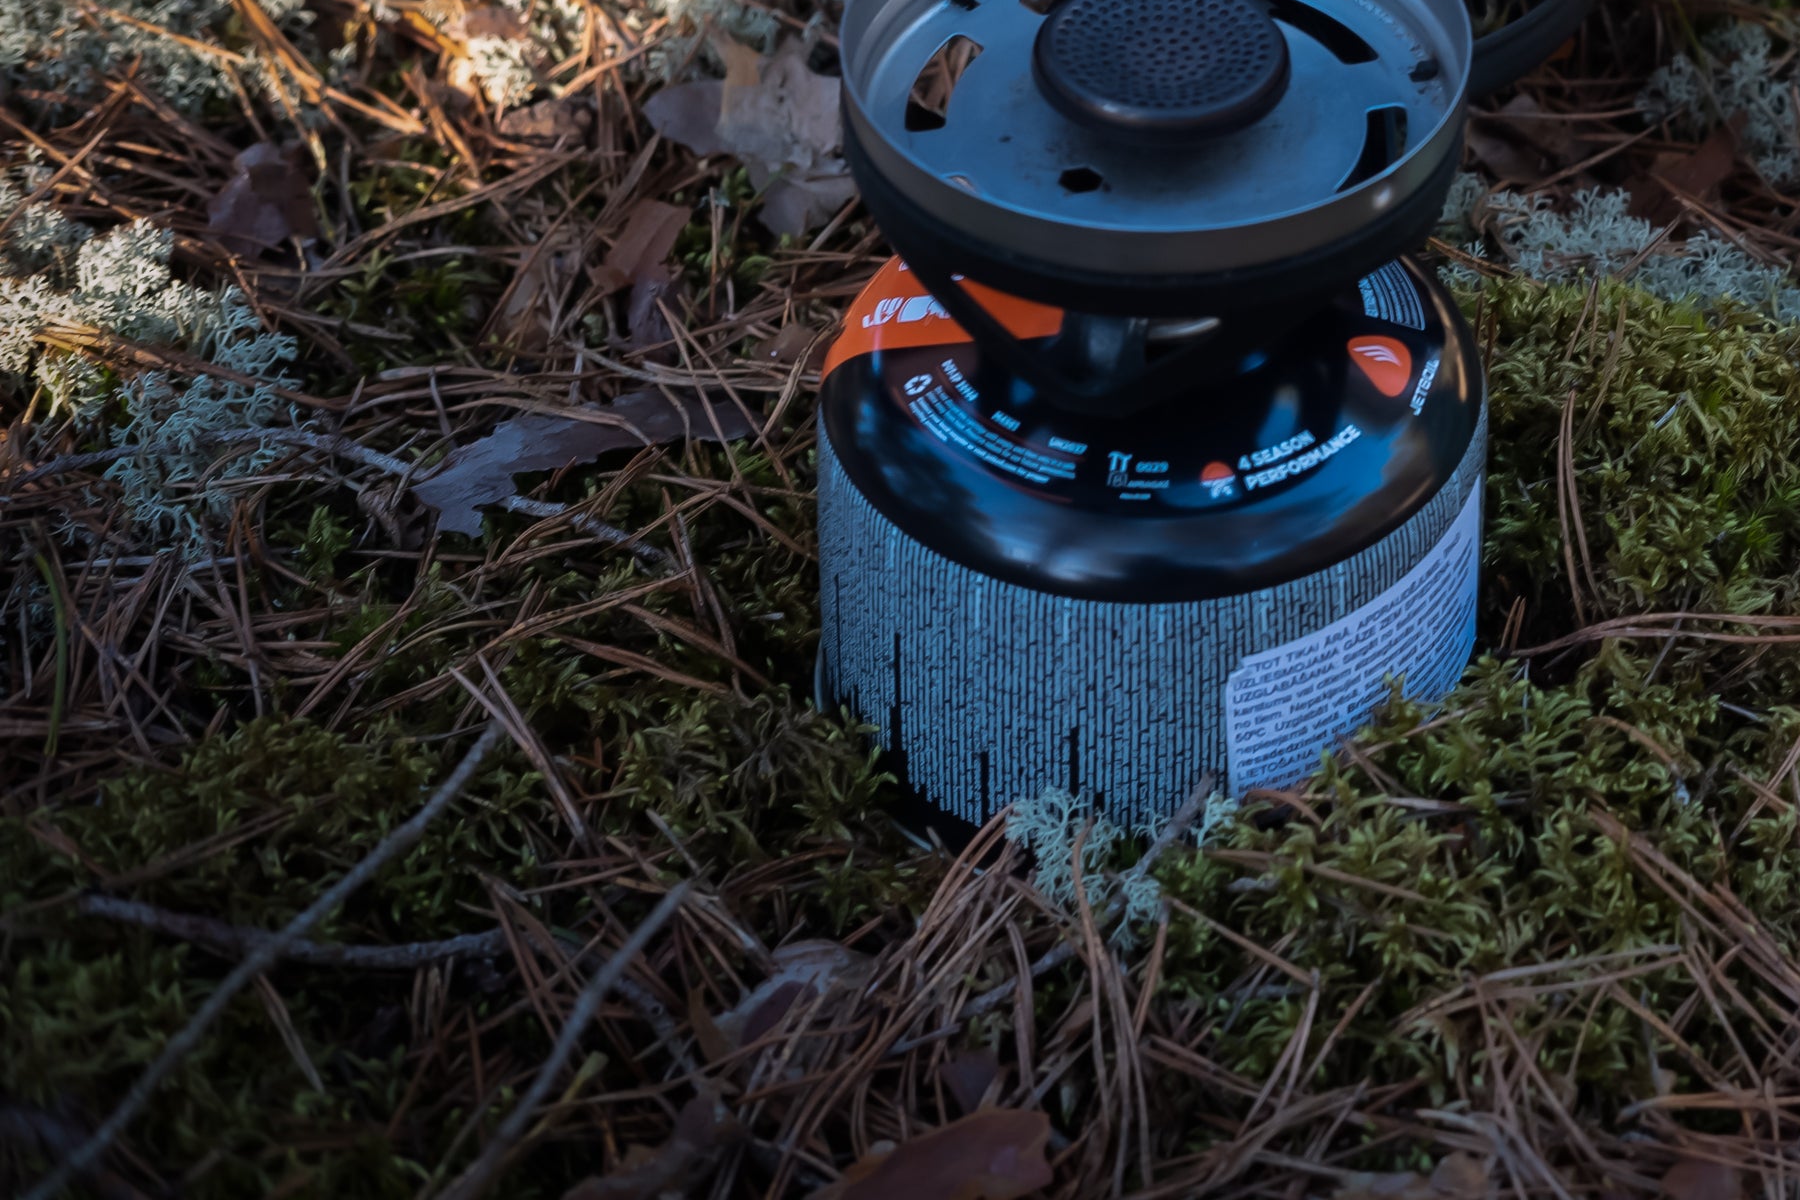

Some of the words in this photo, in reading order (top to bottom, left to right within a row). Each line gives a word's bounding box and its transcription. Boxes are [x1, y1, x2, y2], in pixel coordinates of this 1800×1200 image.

[1236, 454, 1252, 471] 4
[1251, 428, 1316, 468] SEASON
[1242, 423, 1362, 492] PERFORMANCE
